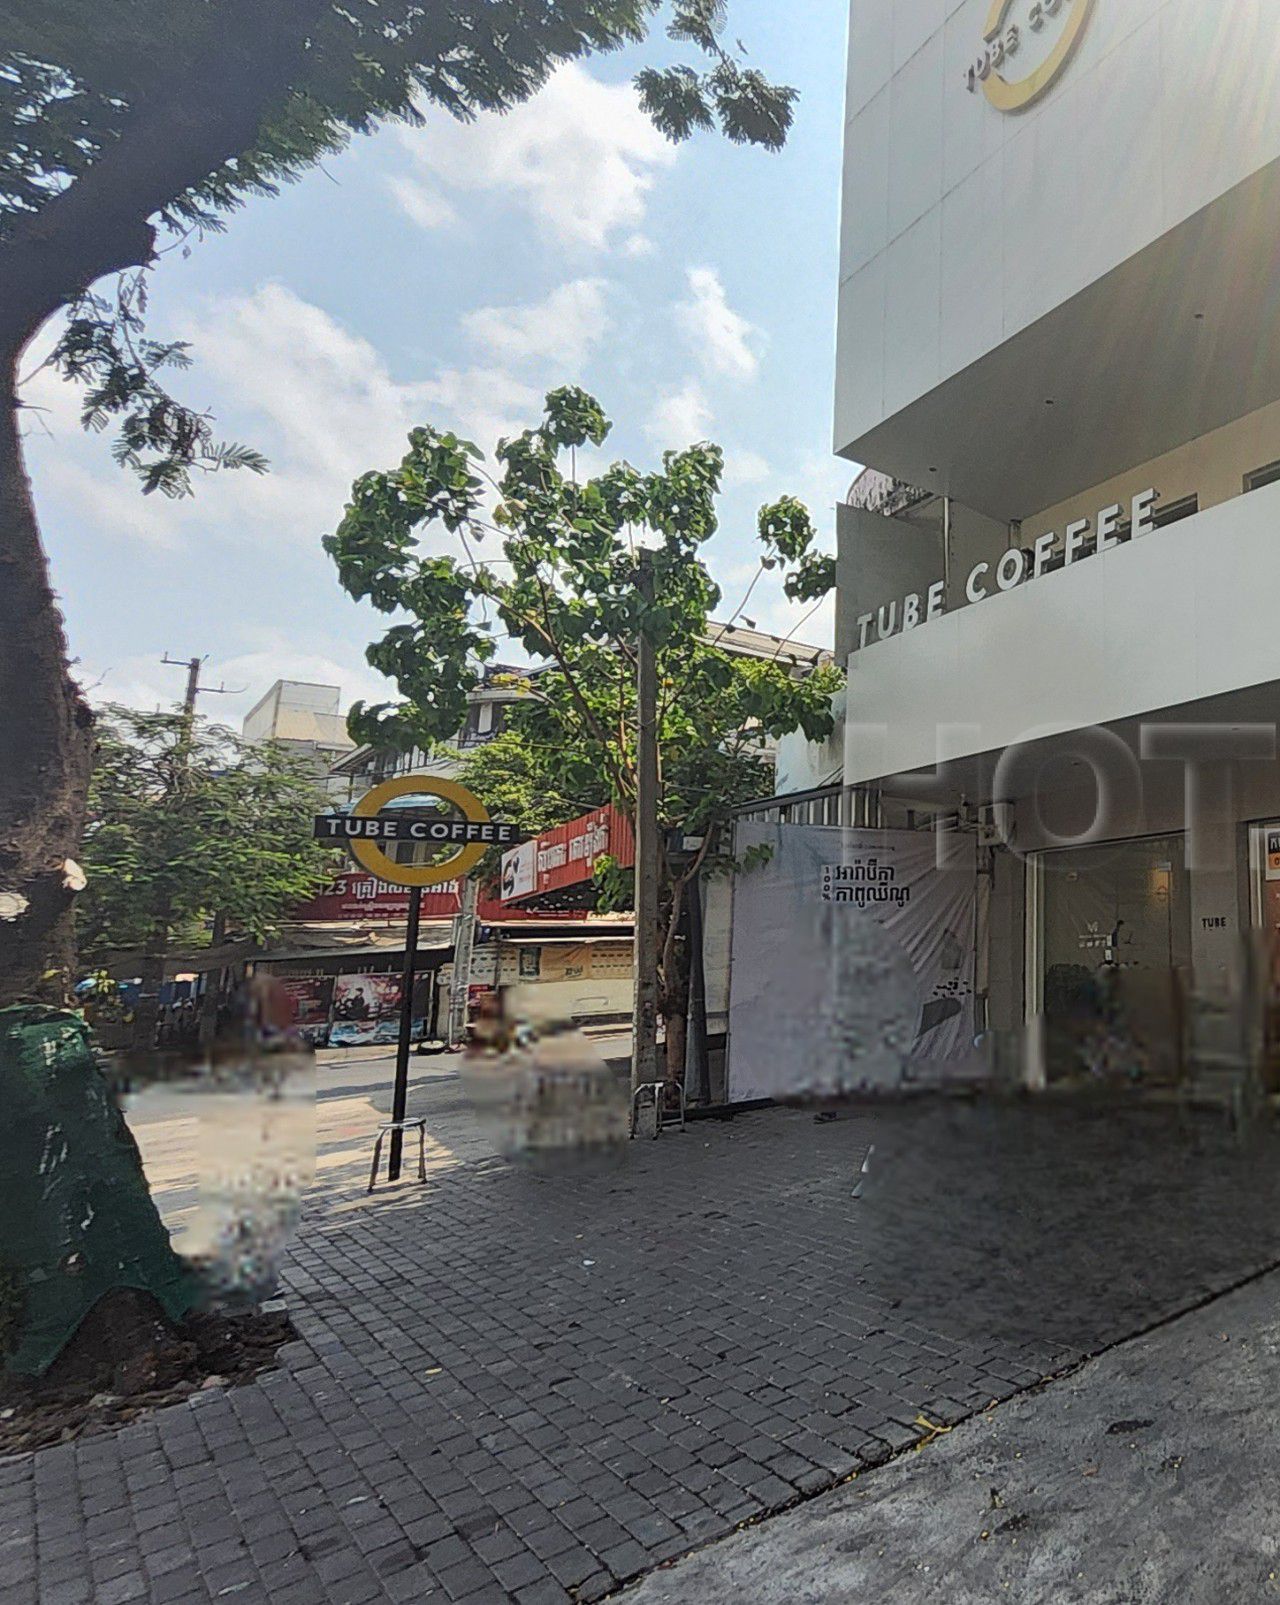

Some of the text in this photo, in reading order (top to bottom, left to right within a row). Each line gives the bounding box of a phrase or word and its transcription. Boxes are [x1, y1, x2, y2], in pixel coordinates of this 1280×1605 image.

[856, 487, 1155, 650] TUBE COFFEE
[325, 818, 512, 841] TUBE COFFEE
[1201, 916, 1227, 928] TUBE
